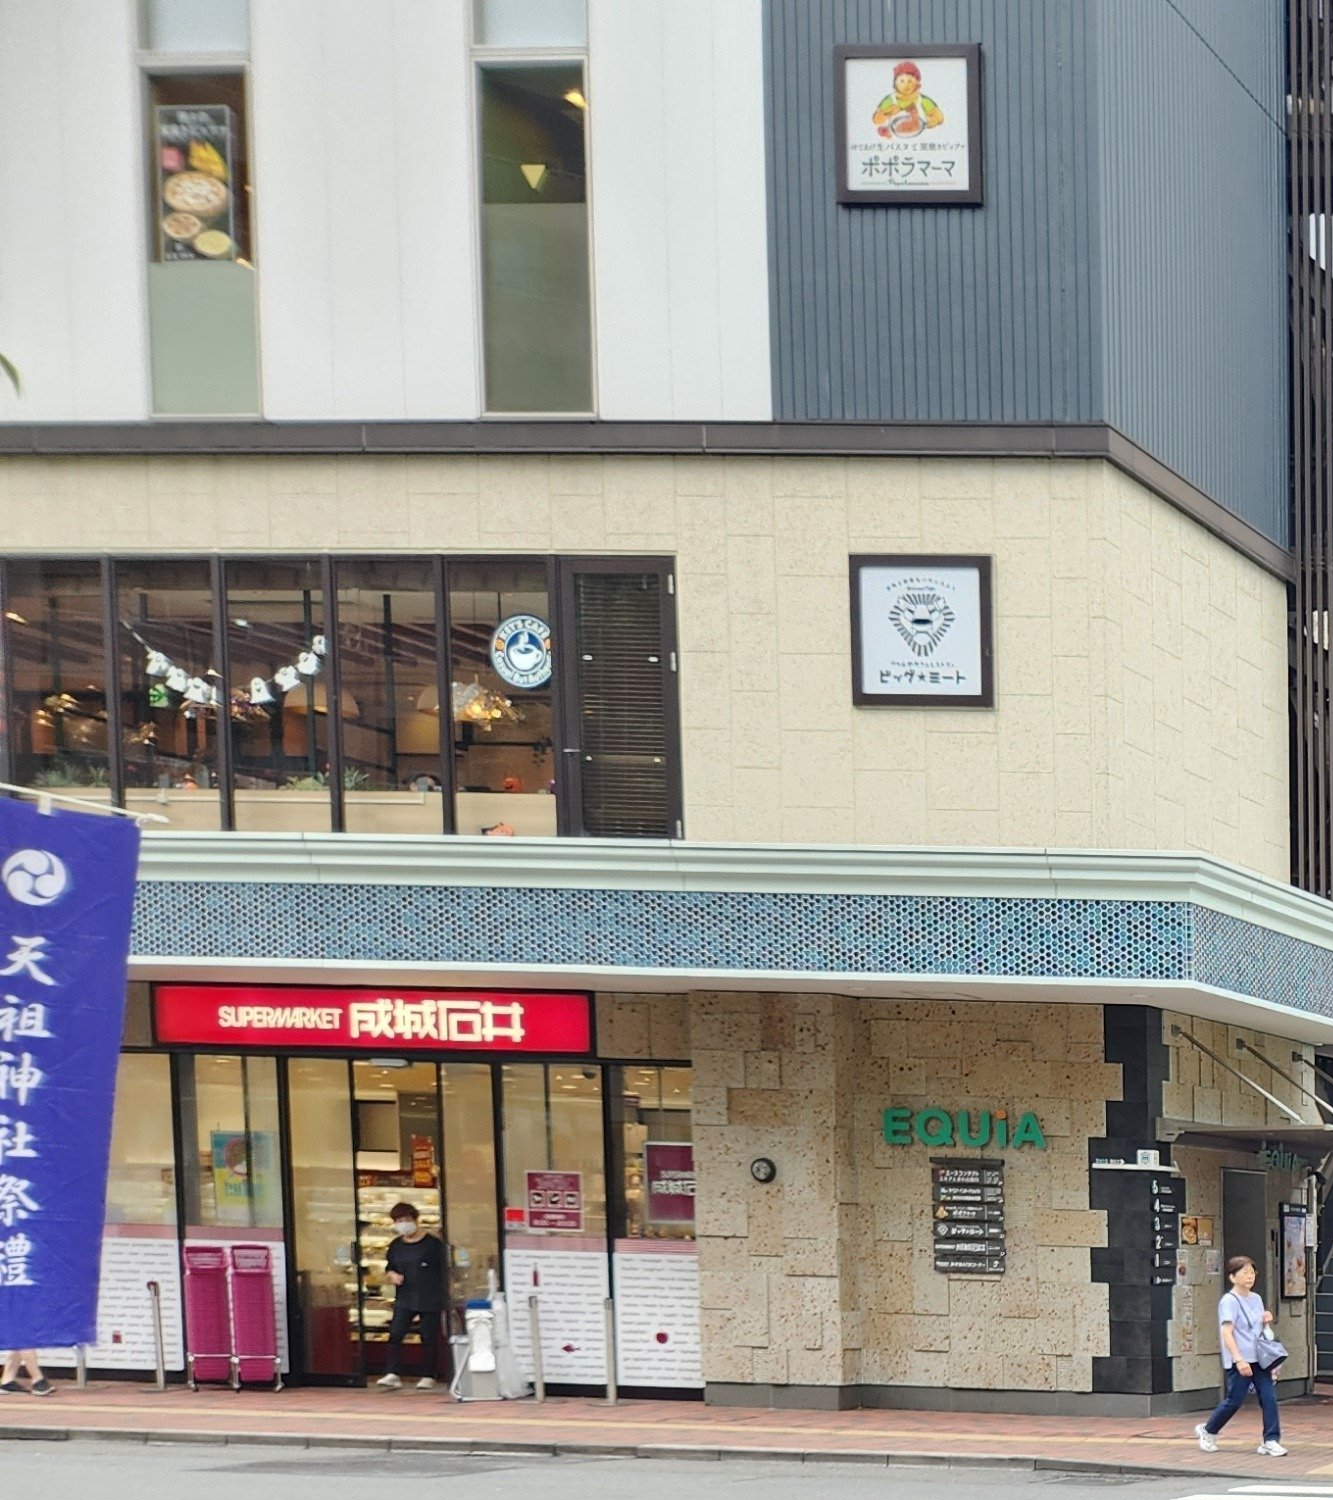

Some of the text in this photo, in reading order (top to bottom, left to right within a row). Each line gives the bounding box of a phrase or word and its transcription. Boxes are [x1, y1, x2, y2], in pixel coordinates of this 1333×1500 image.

[861, 155, 956, 178] ポポラマーマ
[217, 1004, 344, 1030] SUPERMARKET
[349, 998, 525, 1043] 成城石井
